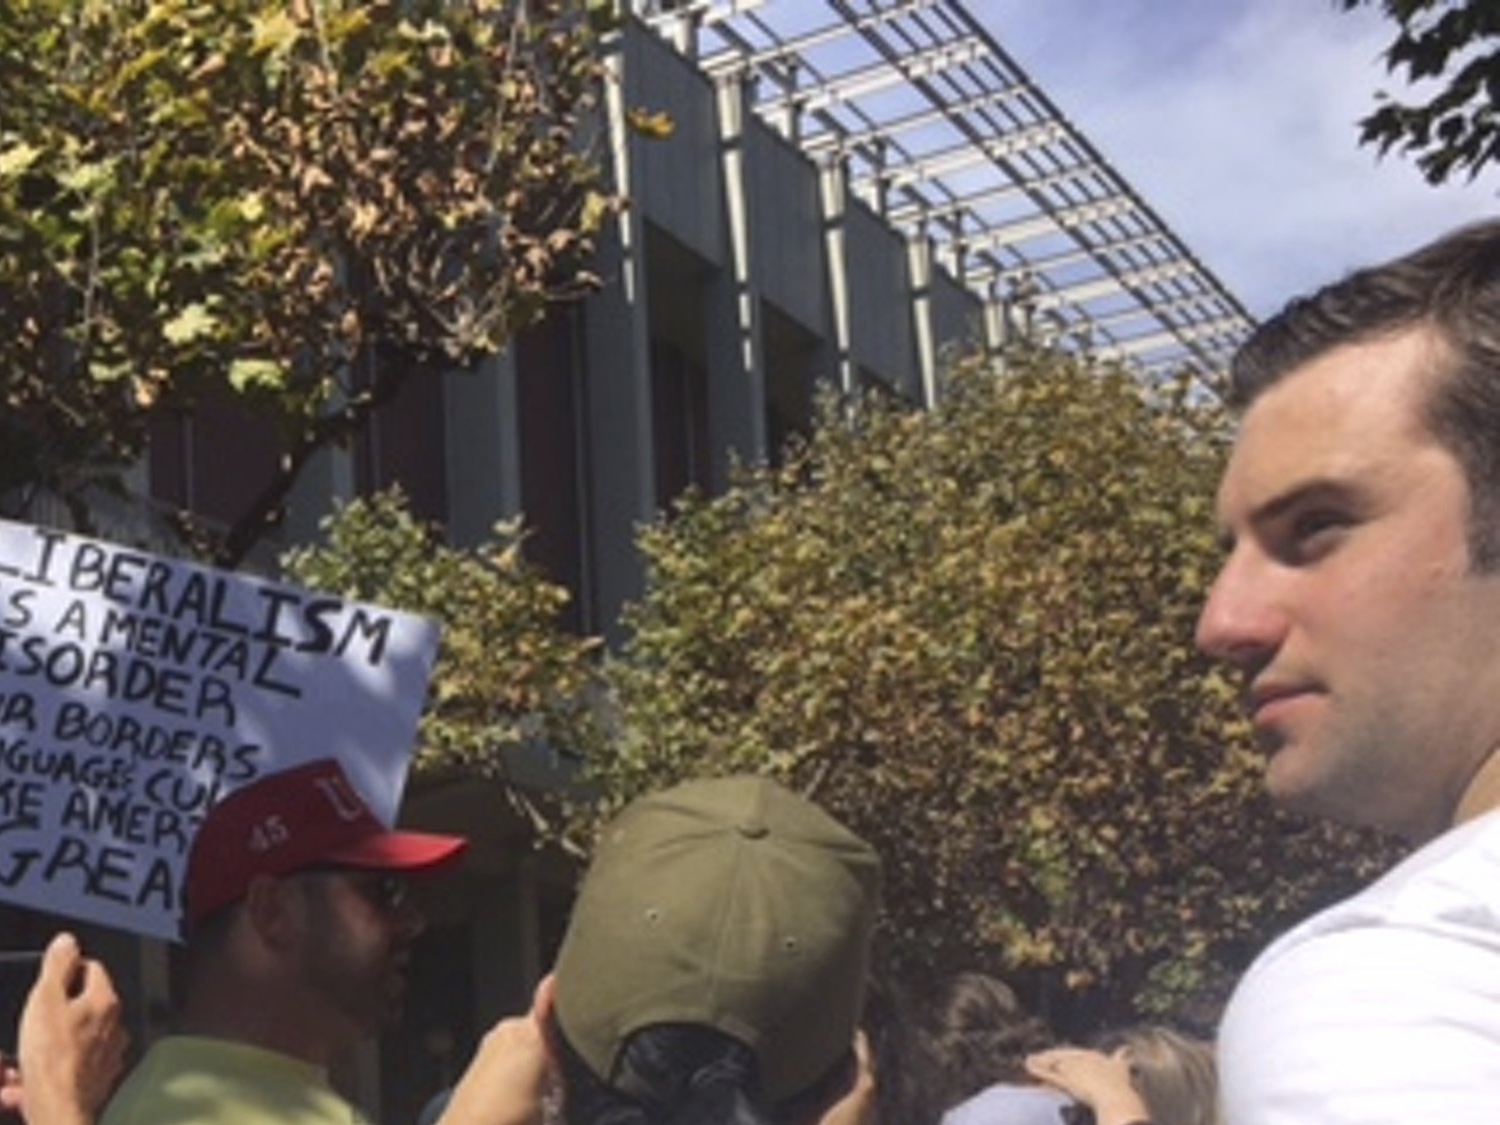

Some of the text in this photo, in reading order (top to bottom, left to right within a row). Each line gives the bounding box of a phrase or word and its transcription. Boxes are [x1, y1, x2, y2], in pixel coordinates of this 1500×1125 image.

[55, 601, 88, 639] A
[99, 609, 302, 698] MENTAL
[55, 701, 260, 781] BORDERS
